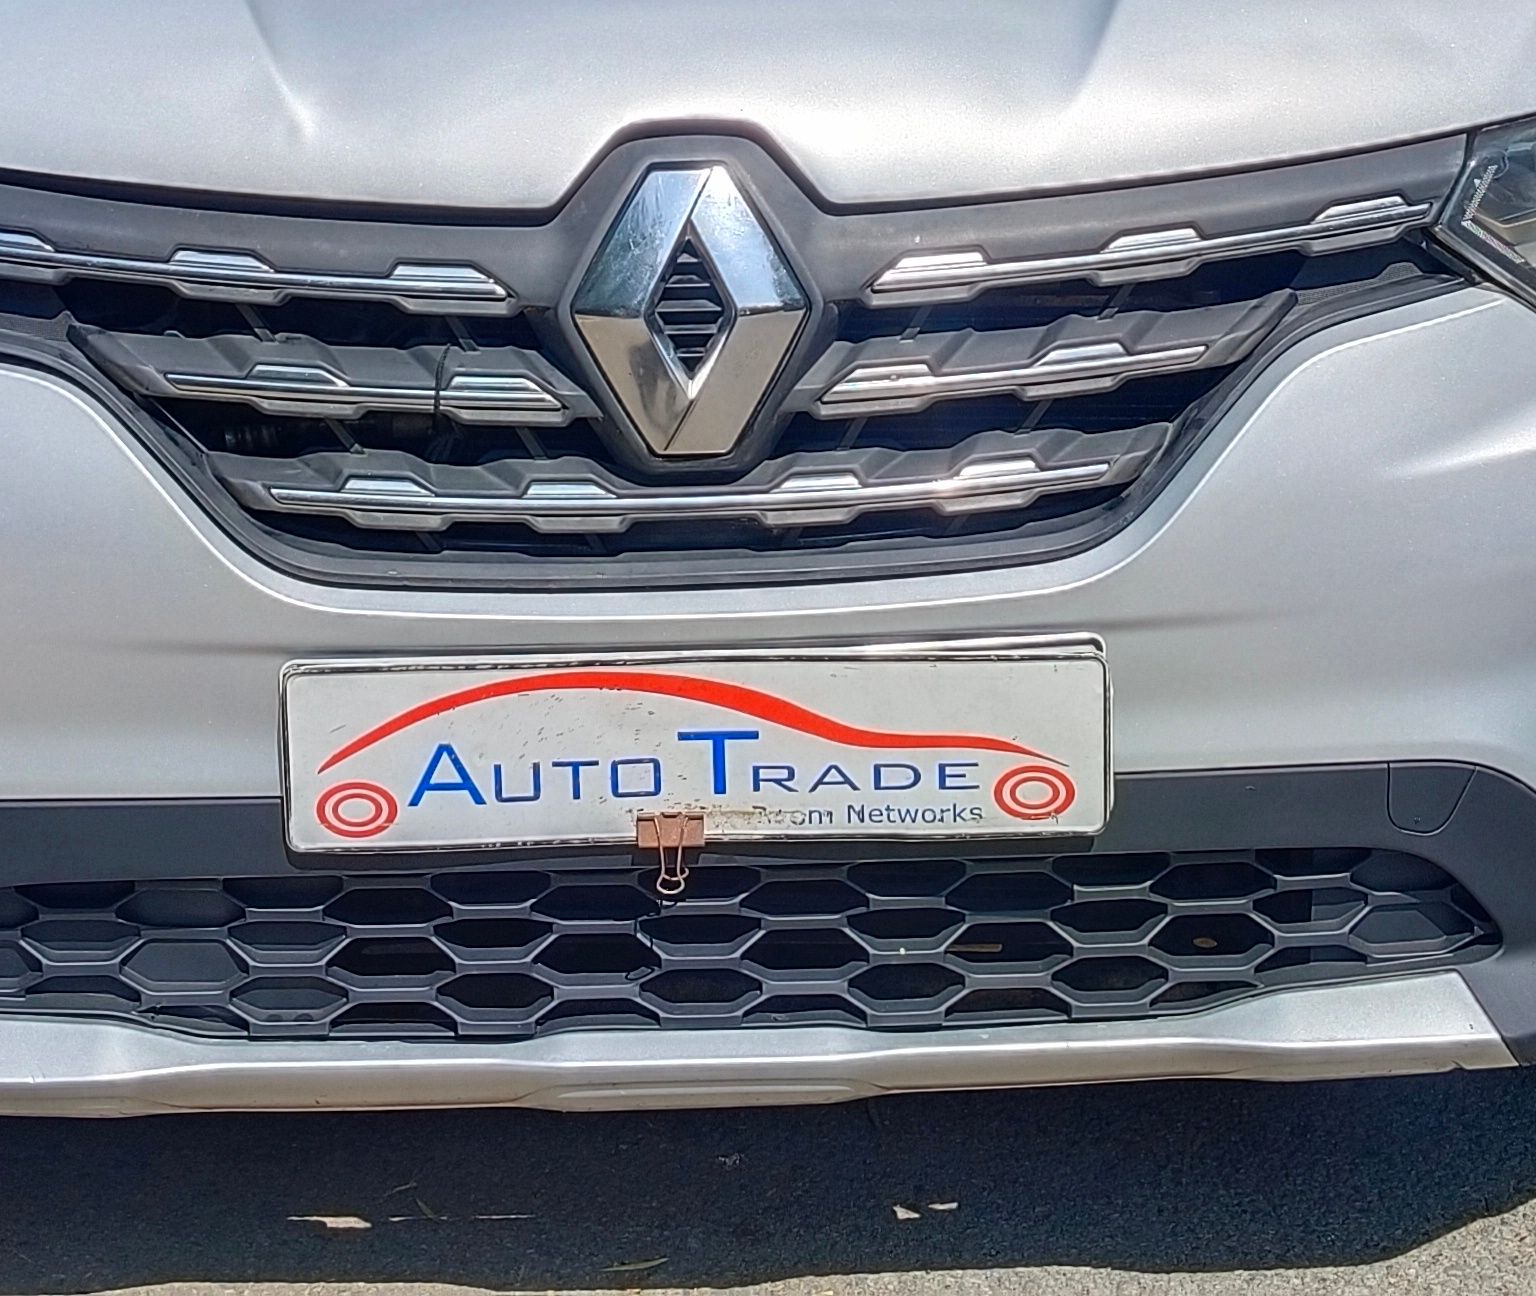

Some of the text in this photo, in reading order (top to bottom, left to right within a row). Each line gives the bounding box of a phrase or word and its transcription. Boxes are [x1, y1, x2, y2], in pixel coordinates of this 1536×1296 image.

[407, 729, 981, 807] AUTO TRADE
[846, 803, 983, 825] Networks
